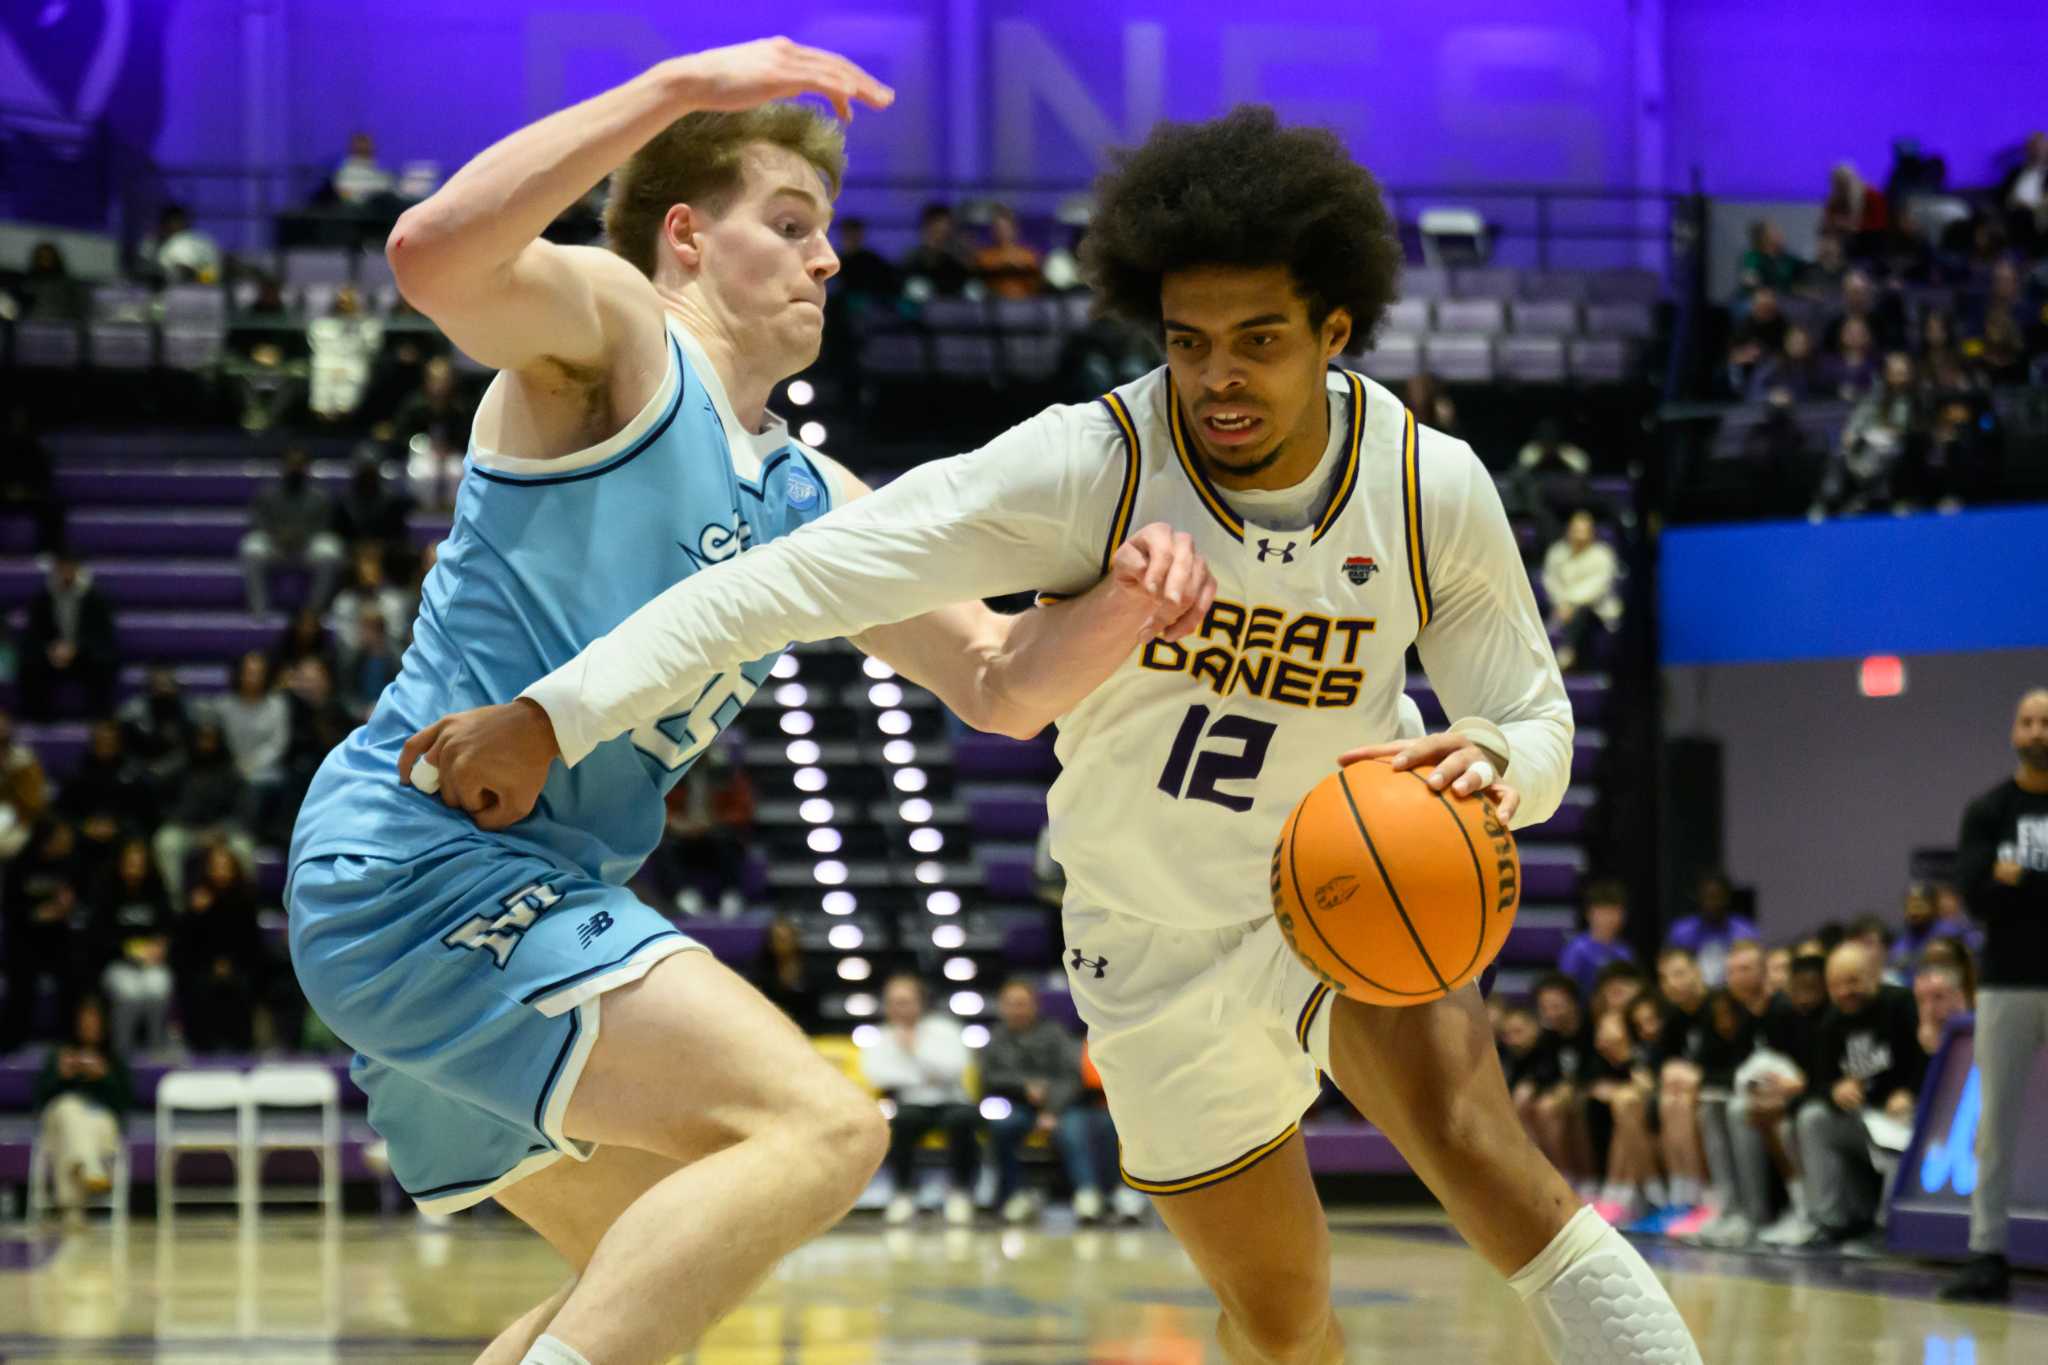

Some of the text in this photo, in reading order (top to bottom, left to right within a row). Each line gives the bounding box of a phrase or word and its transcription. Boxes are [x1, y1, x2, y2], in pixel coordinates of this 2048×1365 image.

[1196, 598, 1377, 667] REAT
[1138, 637, 1366, 709] DANES
[1157, 704, 1278, 812] 12
